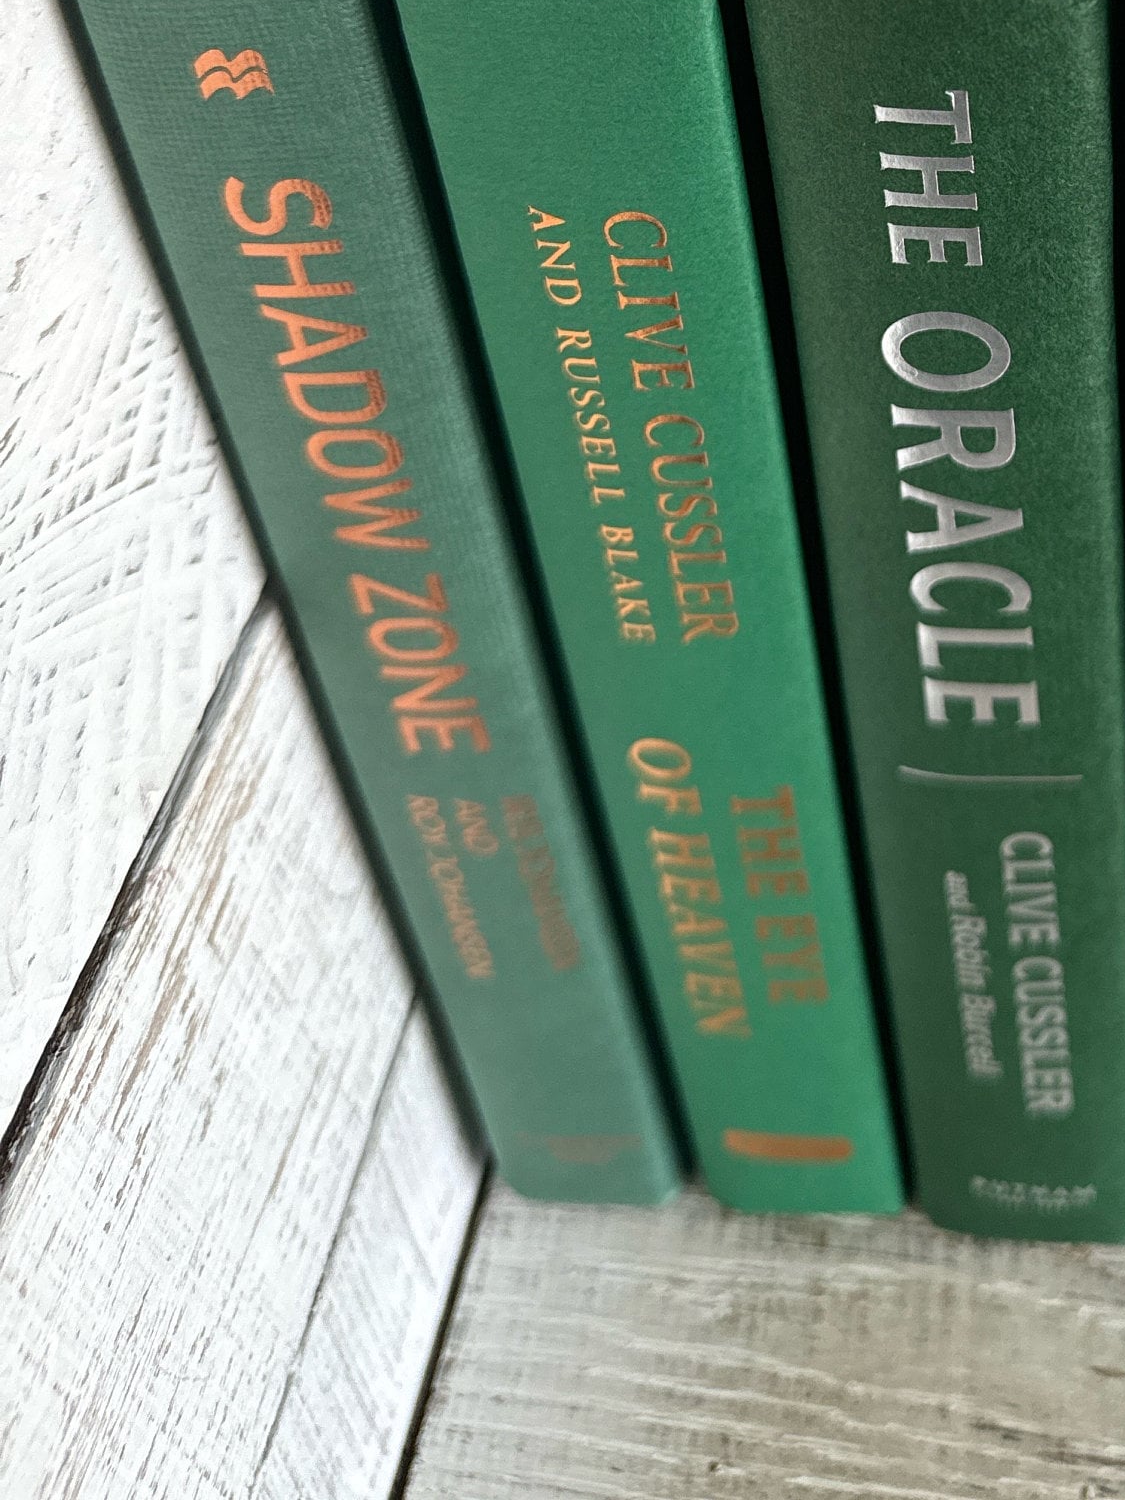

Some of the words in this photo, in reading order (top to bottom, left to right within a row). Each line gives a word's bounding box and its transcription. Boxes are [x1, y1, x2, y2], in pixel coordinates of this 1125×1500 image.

[874, 89, 983, 267] THE
[602, 210, 696, 392] CLIVE
[224, 177, 430, 551] SHADOW
[348, 573, 492, 754] ZONE
[527, 204, 583, 306] AND
[555, 326, 626, 506] RUSSELL
[598, 522, 657, 645] BLAKE
[644, 413, 740, 645] CUSSLER
[881, 311, 1040, 728] ORACLE
[454, 798, 499, 857] AND
[627, 737, 702, 816] OF
[731, 785, 810, 898] THE
[650, 828, 754, 1040] HEAVEN
[755, 913, 830, 1005] EYE
[944, 869, 975, 912] and
[951, 913, 992, 990] Robin
[1000, 830, 1060, 950] CLIVE
[1012, 955, 1075, 1118] CUSSLER
